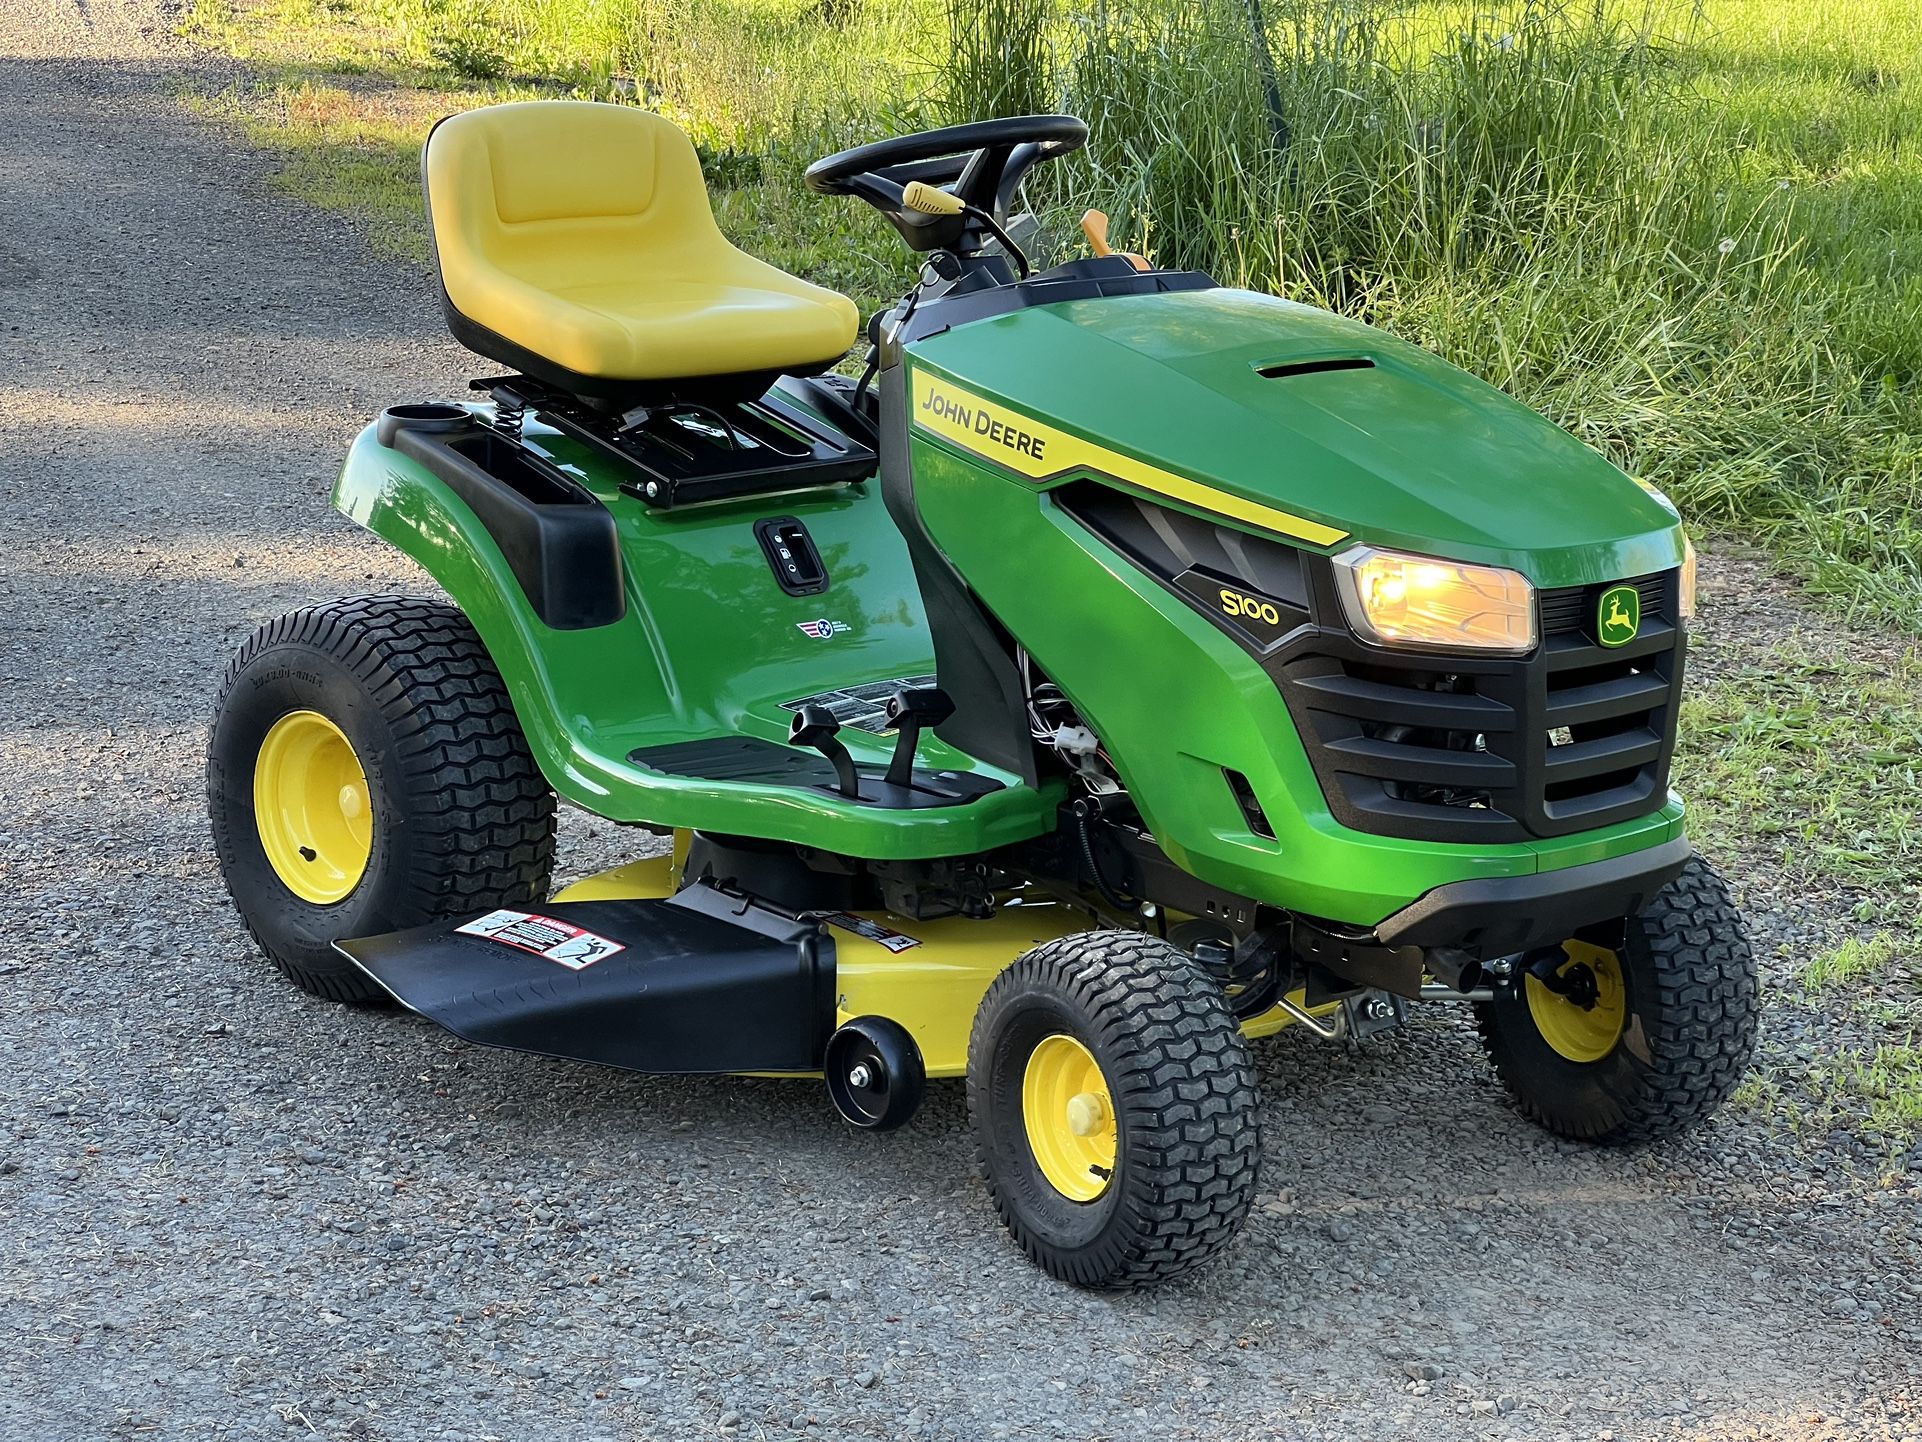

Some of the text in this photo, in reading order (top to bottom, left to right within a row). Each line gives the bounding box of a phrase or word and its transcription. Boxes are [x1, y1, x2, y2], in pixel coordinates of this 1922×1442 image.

[922, 387, 1046, 461] JOHN DEERE
[1219, 589, 1279, 625] S100
